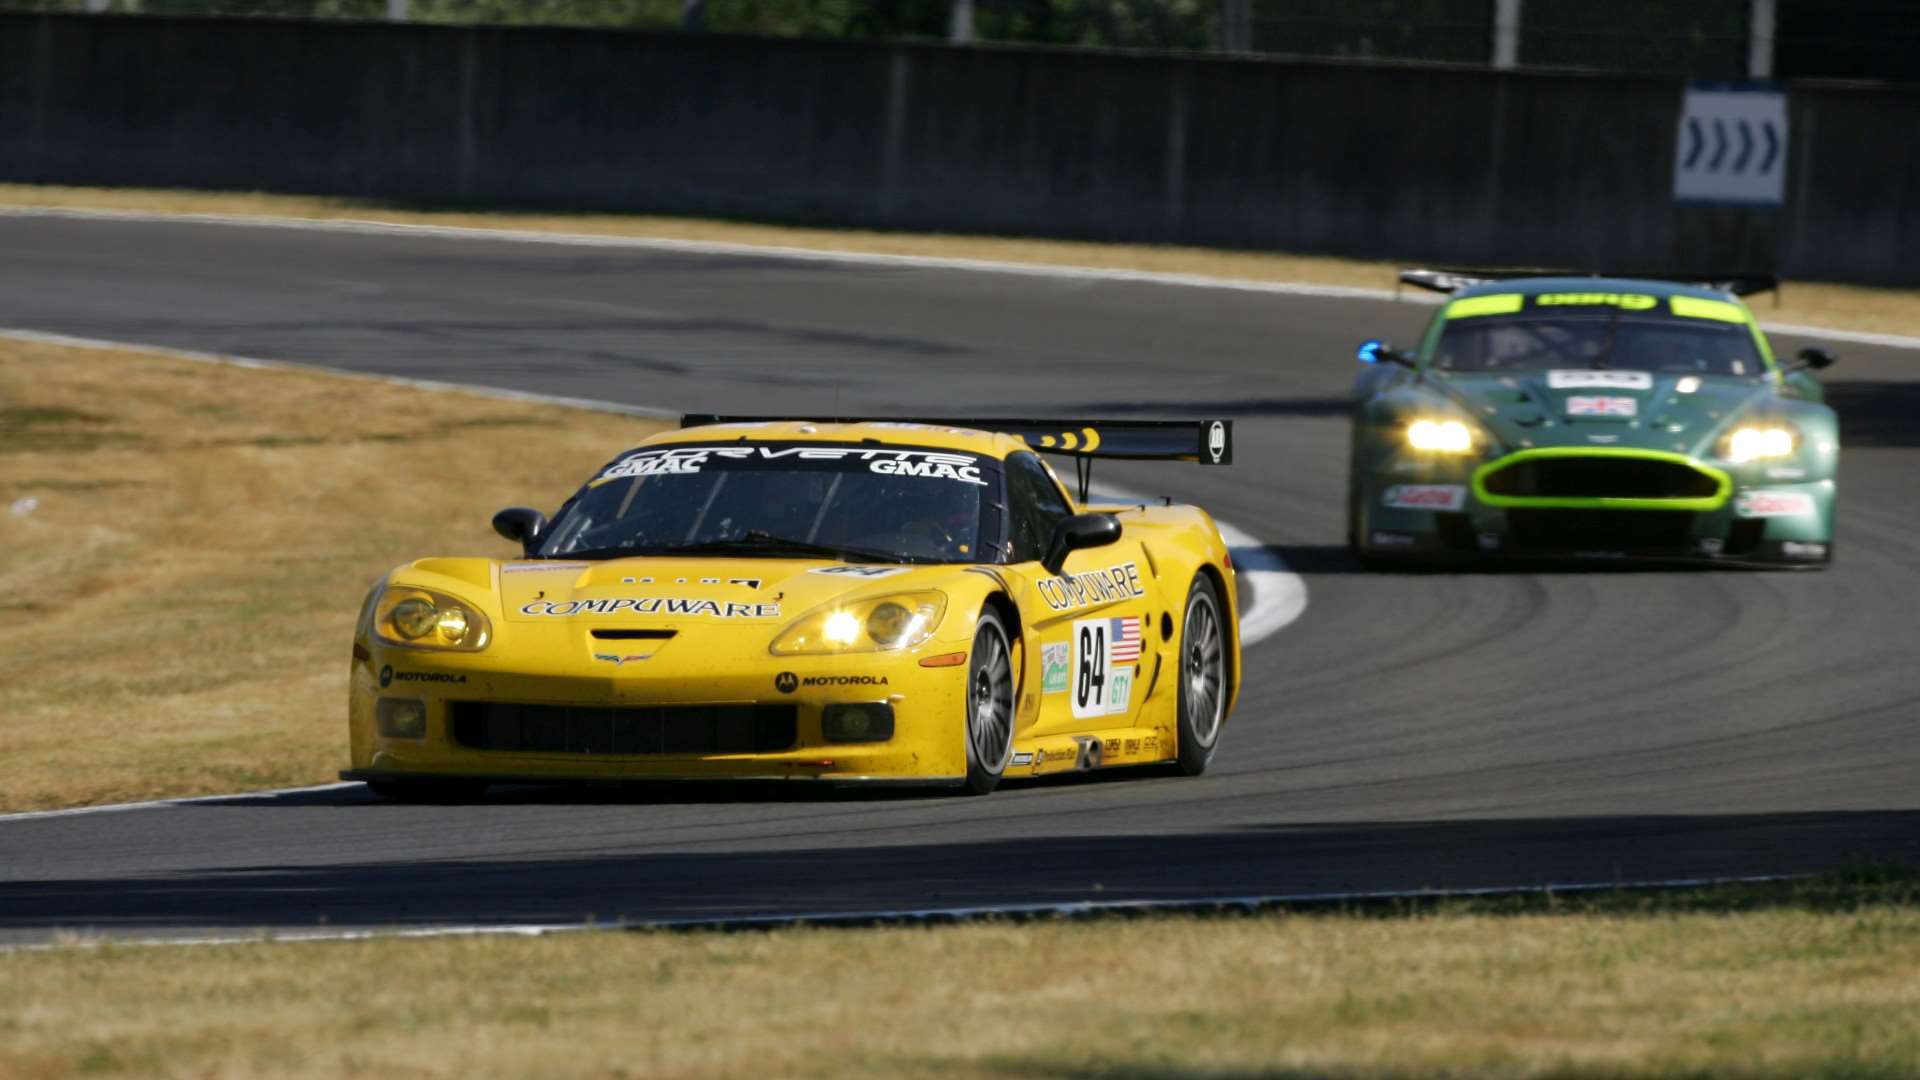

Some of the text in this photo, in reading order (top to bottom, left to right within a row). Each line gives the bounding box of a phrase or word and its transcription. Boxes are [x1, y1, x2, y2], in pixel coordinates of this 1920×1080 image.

[618, 447, 977, 466] CORVETTE
[602, 457, 708, 476] GMAC
[870, 459, 983, 483] GMAC
[1037, 564, 1143, 609] COMPUWARE
[522, 599, 779, 617] COMPUWARE
[1078, 626, 1104, 708] 64
[396, 672, 467, 684] MOTOROLA
[803, 675, 888, 686] MOTOROLA
[1111, 676, 1128, 705] GT1
